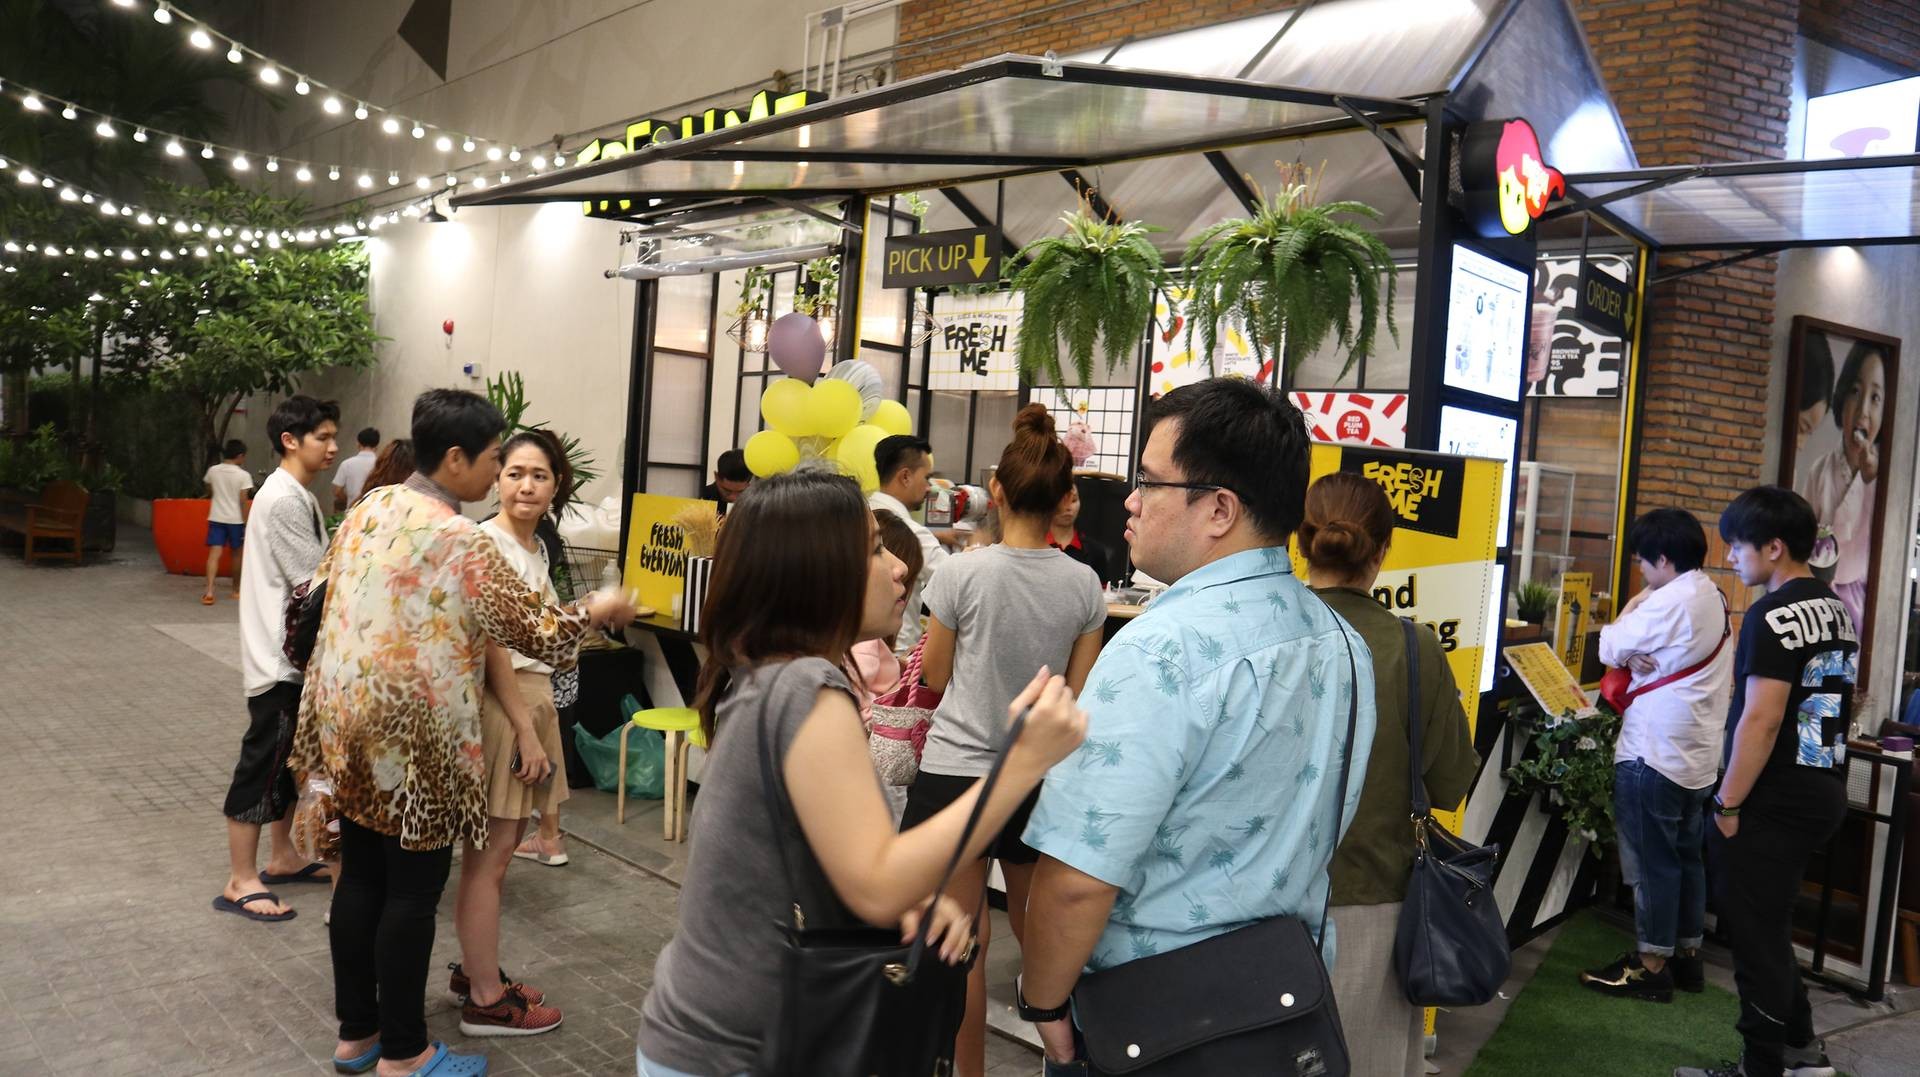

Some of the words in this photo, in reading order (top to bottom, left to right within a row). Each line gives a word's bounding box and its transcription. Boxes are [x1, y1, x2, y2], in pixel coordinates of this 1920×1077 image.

[889, 247, 933, 275] PICK
[938, 244, 968, 271] UP
[1587, 280, 1621, 320] ORDER
[944, 322, 1007, 352] FRESH
[960, 348, 990, 376] ME
[1344, 421, 1363, 429] PLUM
[1363, 461, 1443, 499] FRESH
[650, 521, 685, 551] FRESH
